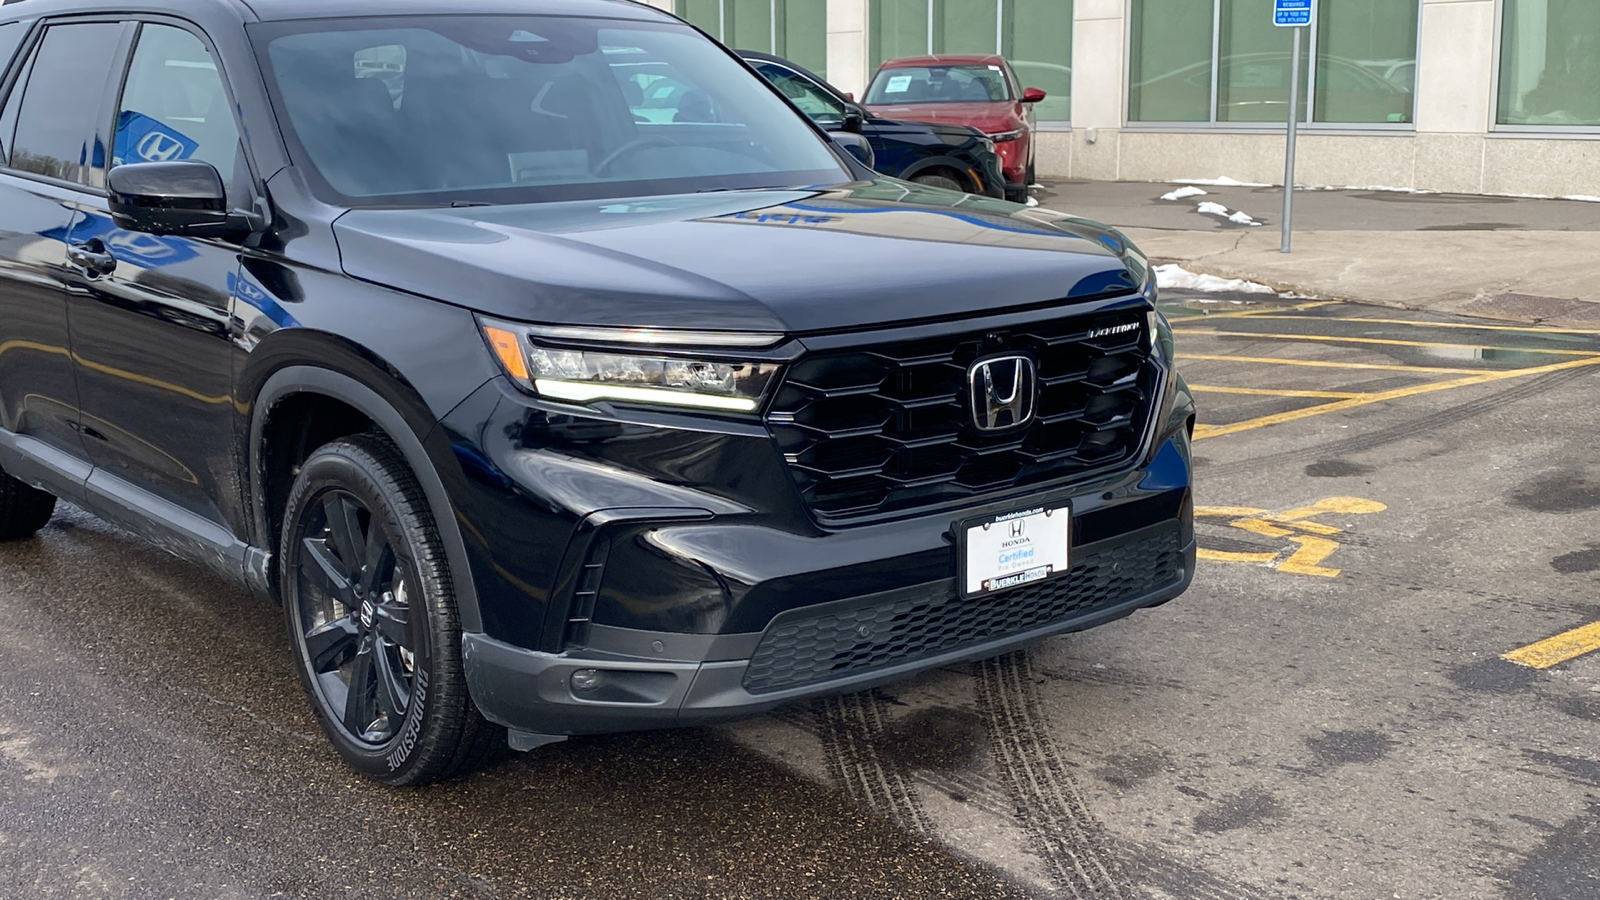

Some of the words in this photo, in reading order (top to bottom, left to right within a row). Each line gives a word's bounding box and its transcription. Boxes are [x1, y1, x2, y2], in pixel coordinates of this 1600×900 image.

[1002, 537, 1031, 548] HONDA
[998, 547, 1034, 564] Certified
[990, 573, 1025, 588] BUERKLE
